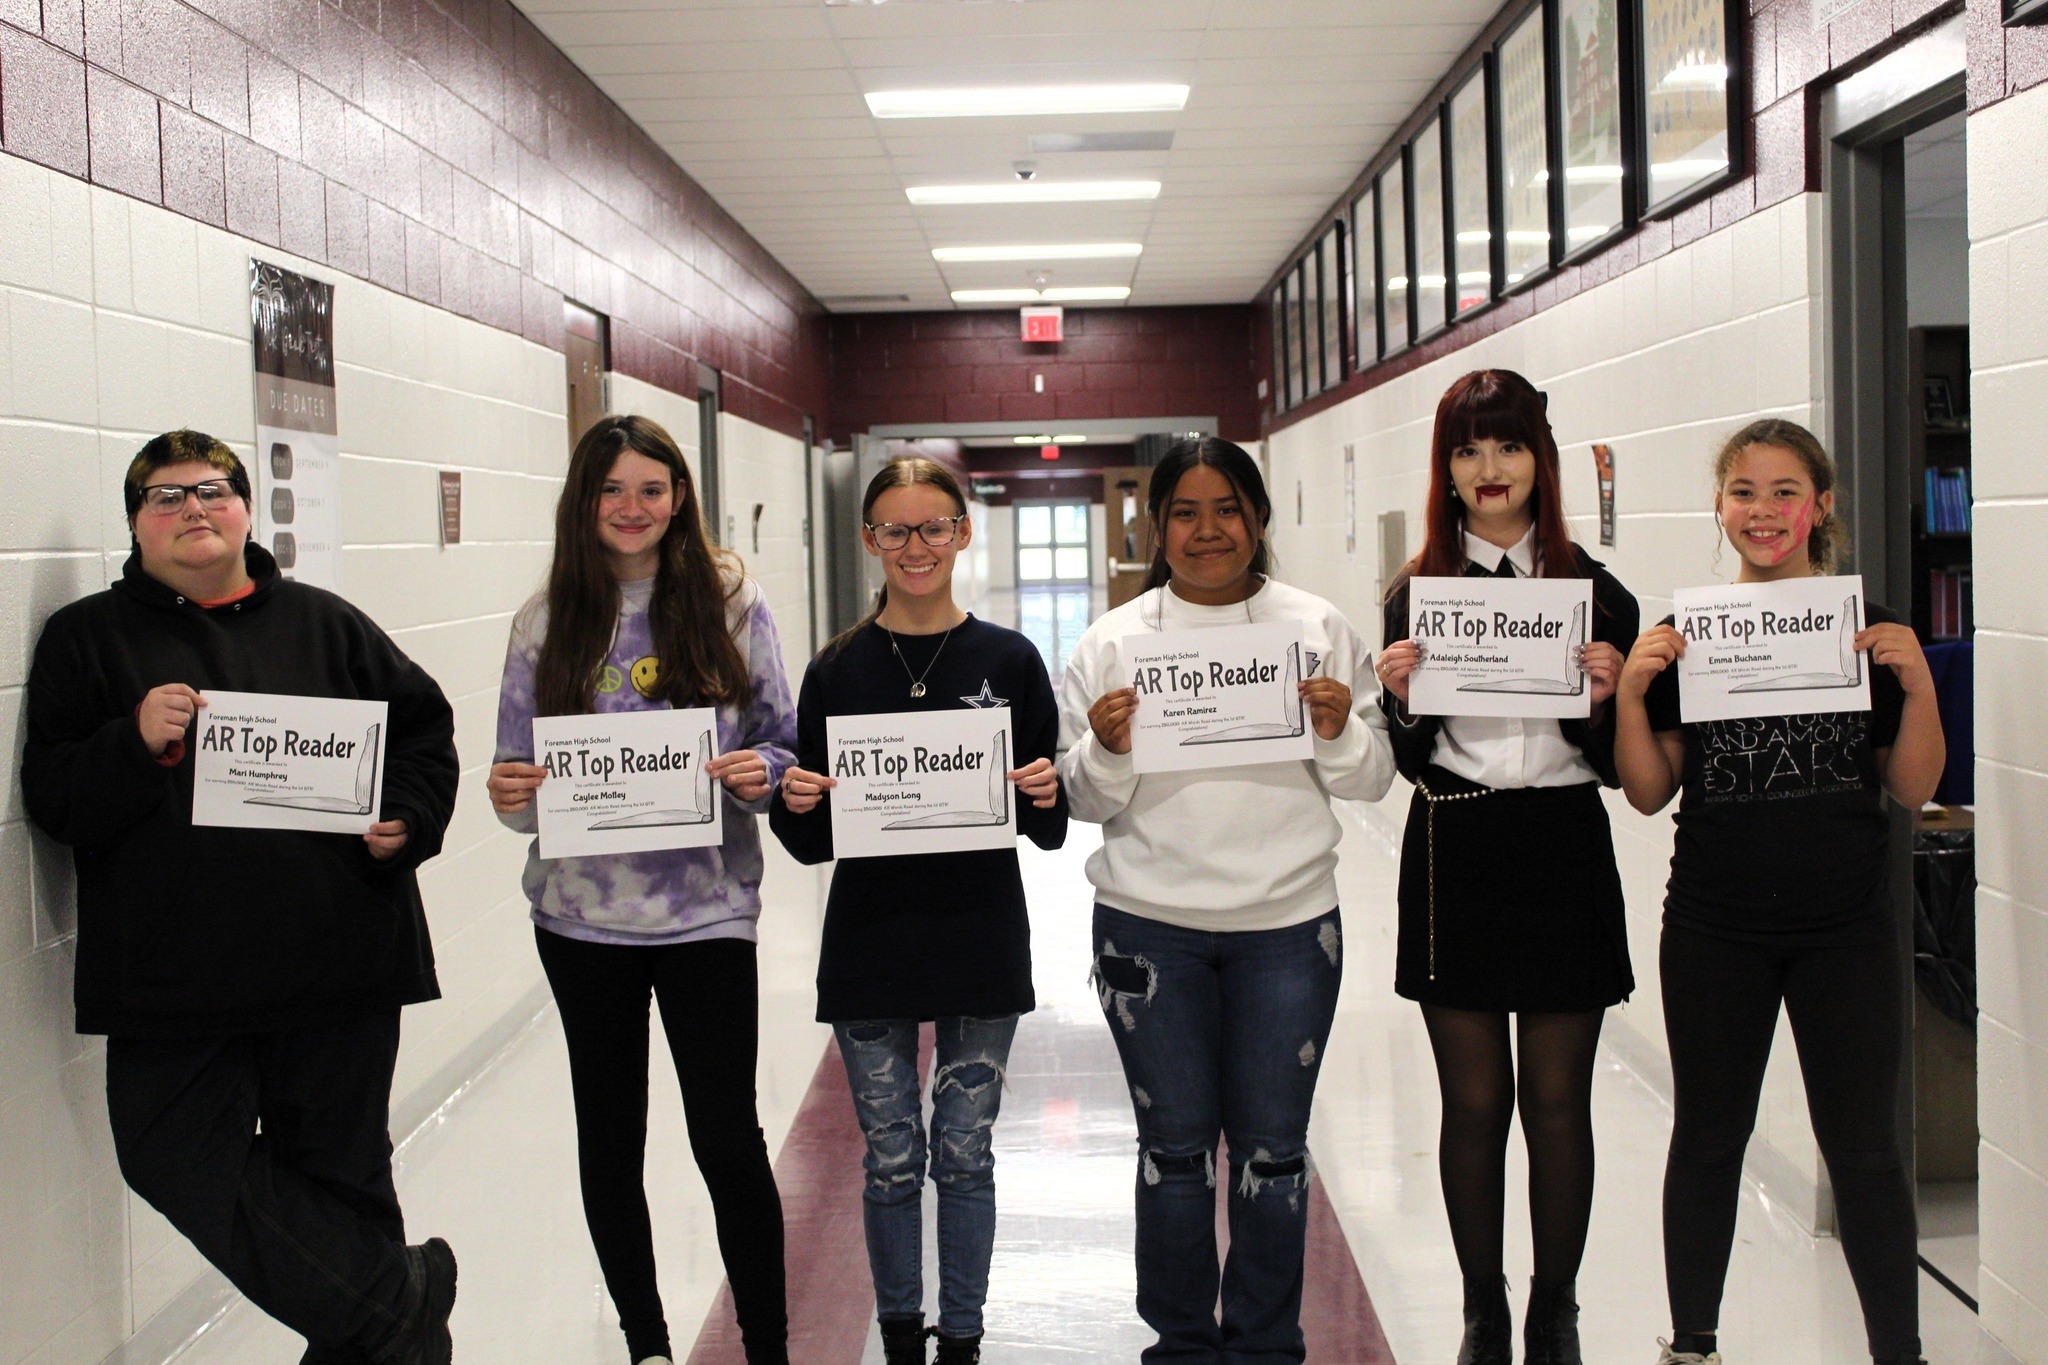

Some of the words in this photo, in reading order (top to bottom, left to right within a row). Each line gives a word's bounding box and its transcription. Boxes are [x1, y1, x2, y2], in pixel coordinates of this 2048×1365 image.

[270, 390, 288, 412] DUE
[293, 394, 325, 417] DATES
[295, 458, 325, 470] SEPTEMBER
[297, 498, 320, 508] OCTOBER
[299, 542, 326, 553] NOVEMBER
[1449, 599, 1463, 608] High
[1415, 610, 1445, 637] AR
[1451, 611, 1487, 645] Top
[1494, 612, 1563, 639] Reader
[1682, 616, 1712, 642] AR
[1717, 614, 1755, 645] Top
[1761, 608, 1834, 636] Reader
[1163, 654, 1177, 662] High
[1178, 652, 1199, 660] School
[1430, 654, 1462, 664] Adaleigh
[1464, 654, 1508, 663] Southerland
[1708, 656, 1732, 664] Emma
[1734, 654, 1772, 662] Buchanan
[1133, 667, 1163, 695] AR
[1167, 665, 1203, 697] Top
[1209, 658, 1278, 688] Reader
[1163, 710, 1186, 718] Karen
[1187, 706, 1217, 715] Ramirez
[209, 713, 237, 721] Foreman
[239, 715, 253, 724] High
[255, 716, 276, 724] School
[1696, 717, 1765, 734] MISS
[1781, 711, 1866, 728] YOULL
[202, 725, 235, 752] AR
[241, 728, 277, 762] Top
[284, 730, 356, 759] Reader
[574, 738, 588, 746] High
[867, 737, 882, 745] High
[1702, 731, 1758, 753] LAND
[1767, 724, 1866, 748] AMONG
[544, 751, 572, 779] AR
[577, 750, 614, 783] Top
[620, 745, 690, 773] Reader
[836, 750, 866, 778] AR
[870, 749, 908, 782] Top
[914, 744, 984, 773] Reader
[1714, 741, 1860, 793] STARS
[229, 768, 247, 776] Mari
[249, 770, 288, 782] Humphrey
[1704, 758, 1716, 793] THE
[572, 794, 598, 803] Caylee
[600, 791, 626, 800] Motley
[865, 792, 900, 802] Madyson
[902, 792, 921, 800] Long
